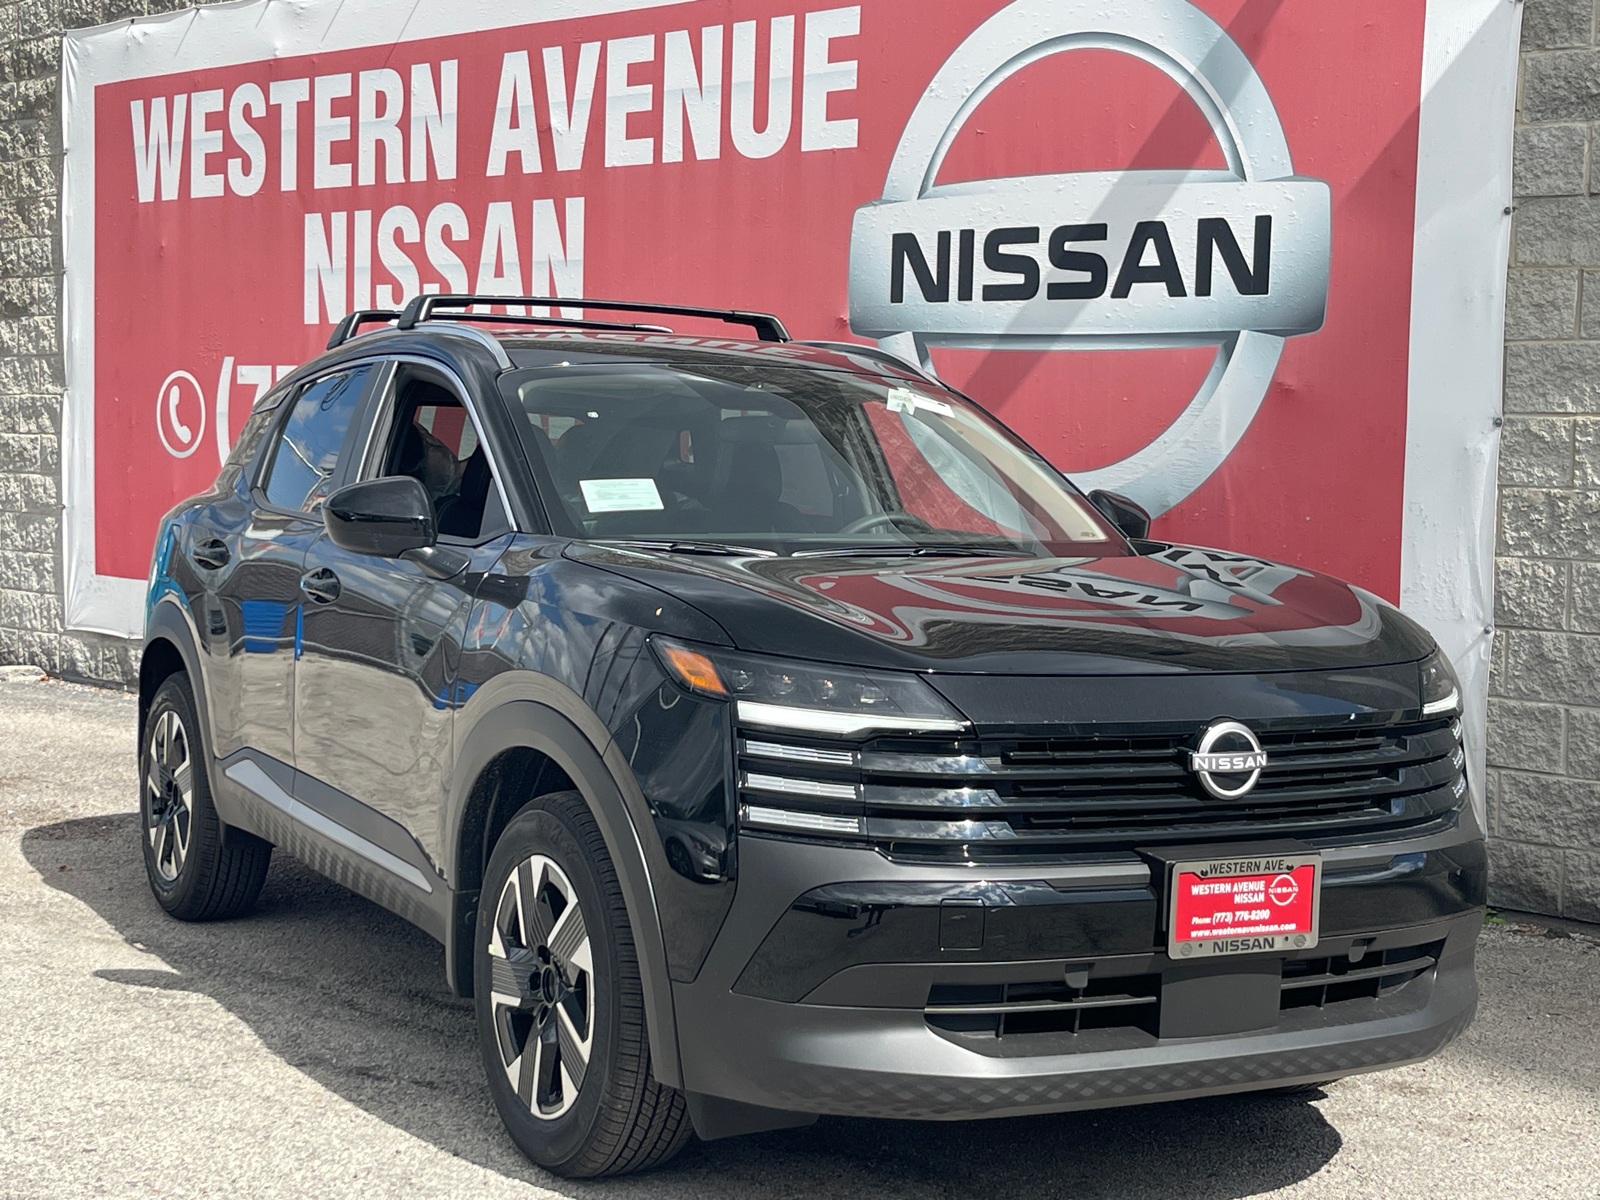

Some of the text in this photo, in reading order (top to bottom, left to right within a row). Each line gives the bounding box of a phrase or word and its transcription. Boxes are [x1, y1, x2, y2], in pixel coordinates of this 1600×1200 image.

[130, 5, 862, 203] WESTERN AVENUE
[304, 197, 585, 325] NISSAN
[890, 215, 1272, 304] NISSAN
[1194, 754, 1267, 770] NISSAN
[1209, 861, 1261, 875] WESTERN
[1191, 881, 1266, 895] WESTERN AVENUE
[1268, 886, 1299, 894] NISSAN
[1234, 892, 1265, 904] NISSAN
[1212, 912, 1233, 925] (773)
[1234, 909, 1271, 921] 776-8200
[1190, 923, 1297, 938] www.westernavenissan.com
[1213, 937, 1275, 953] NISSAN
